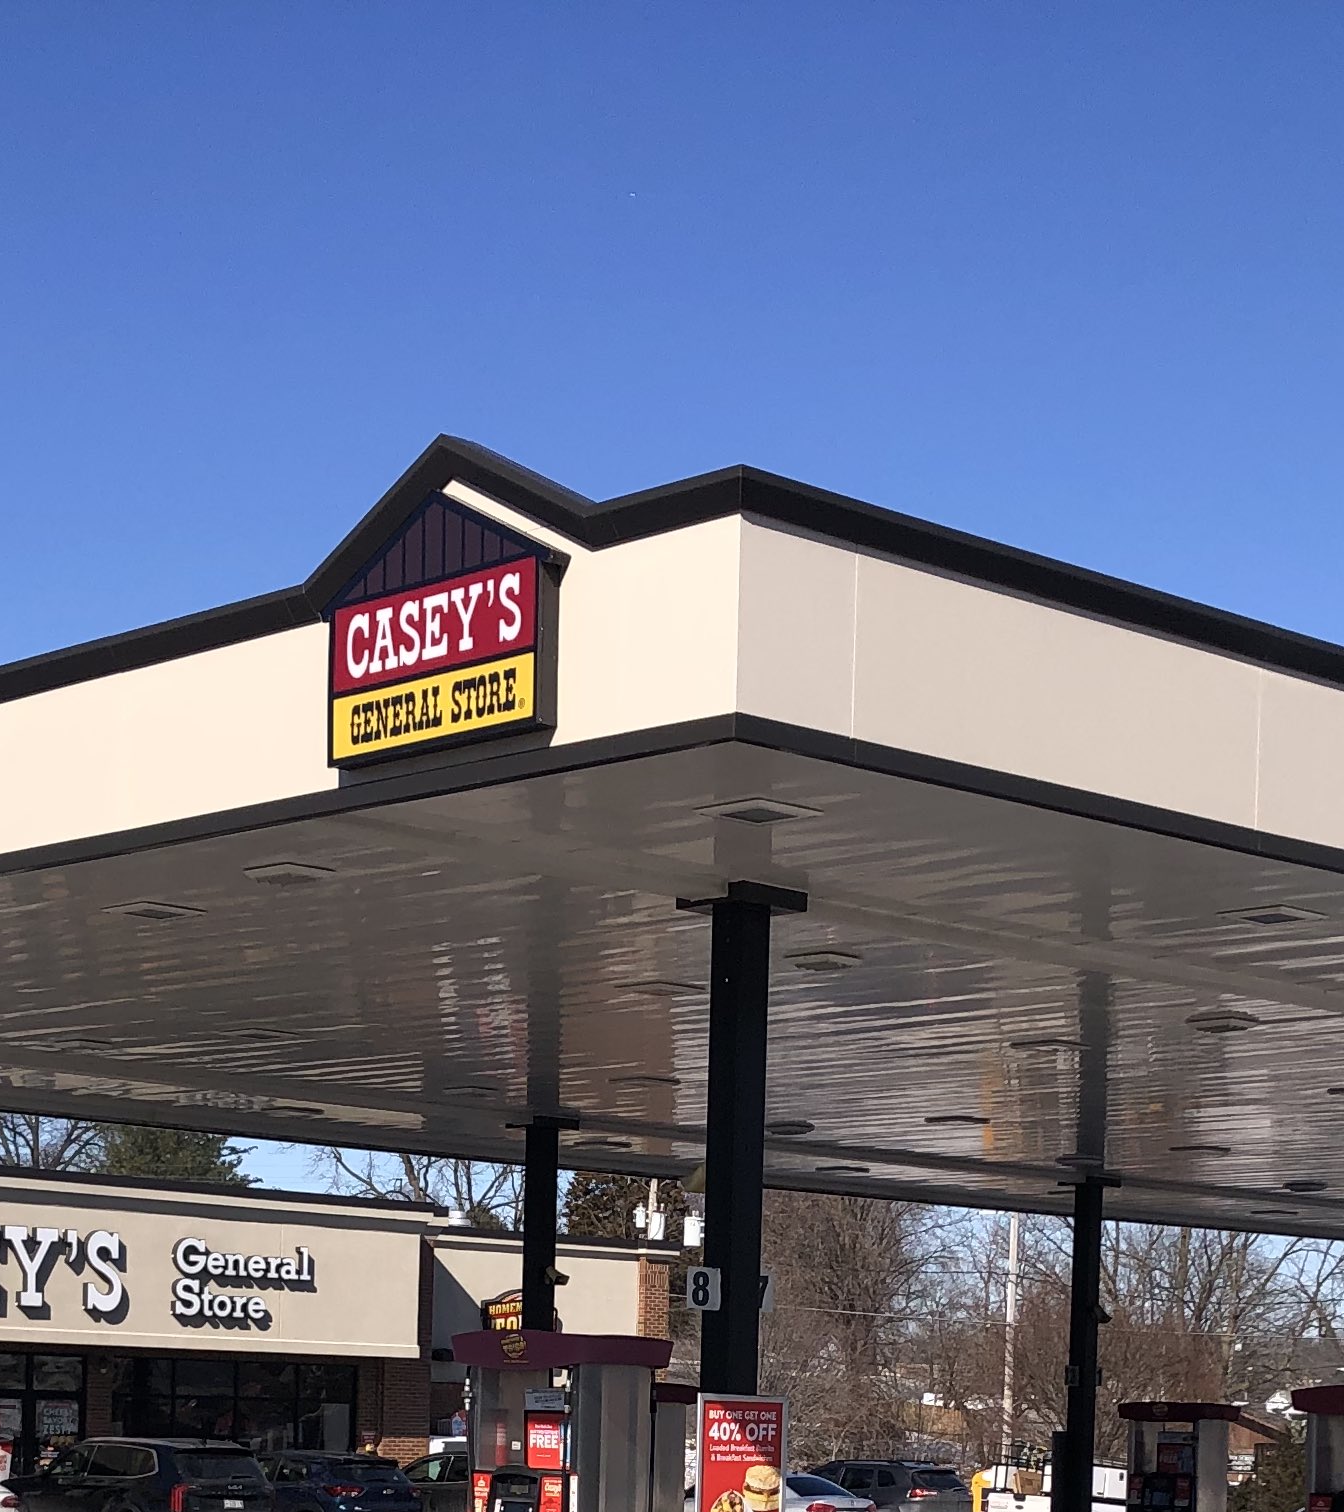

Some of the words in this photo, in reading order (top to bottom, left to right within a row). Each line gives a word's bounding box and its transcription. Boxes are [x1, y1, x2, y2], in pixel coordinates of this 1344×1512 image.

[346, 572, 522, 679] CASEY'S
[349, 685, 443, 746] GENERAL
[451, 667, 517, 723] STORE
[174, 1237, 313, 1282] General
[174, 1278, 267, 1319] Store
[692, 1271, 709, 1306] 8
[708, 1422, 742, 1442] 40%
[745, 1423, 778, 1442] OFF
[709, 1410, 725, 1420] BUY
[725, 1410, 743, 1420] ONE
[745, 1411, 759, 1420] GET
[760, 1411, 777, 1420] ONE
[529, 1434, 559, 1449] FREE
